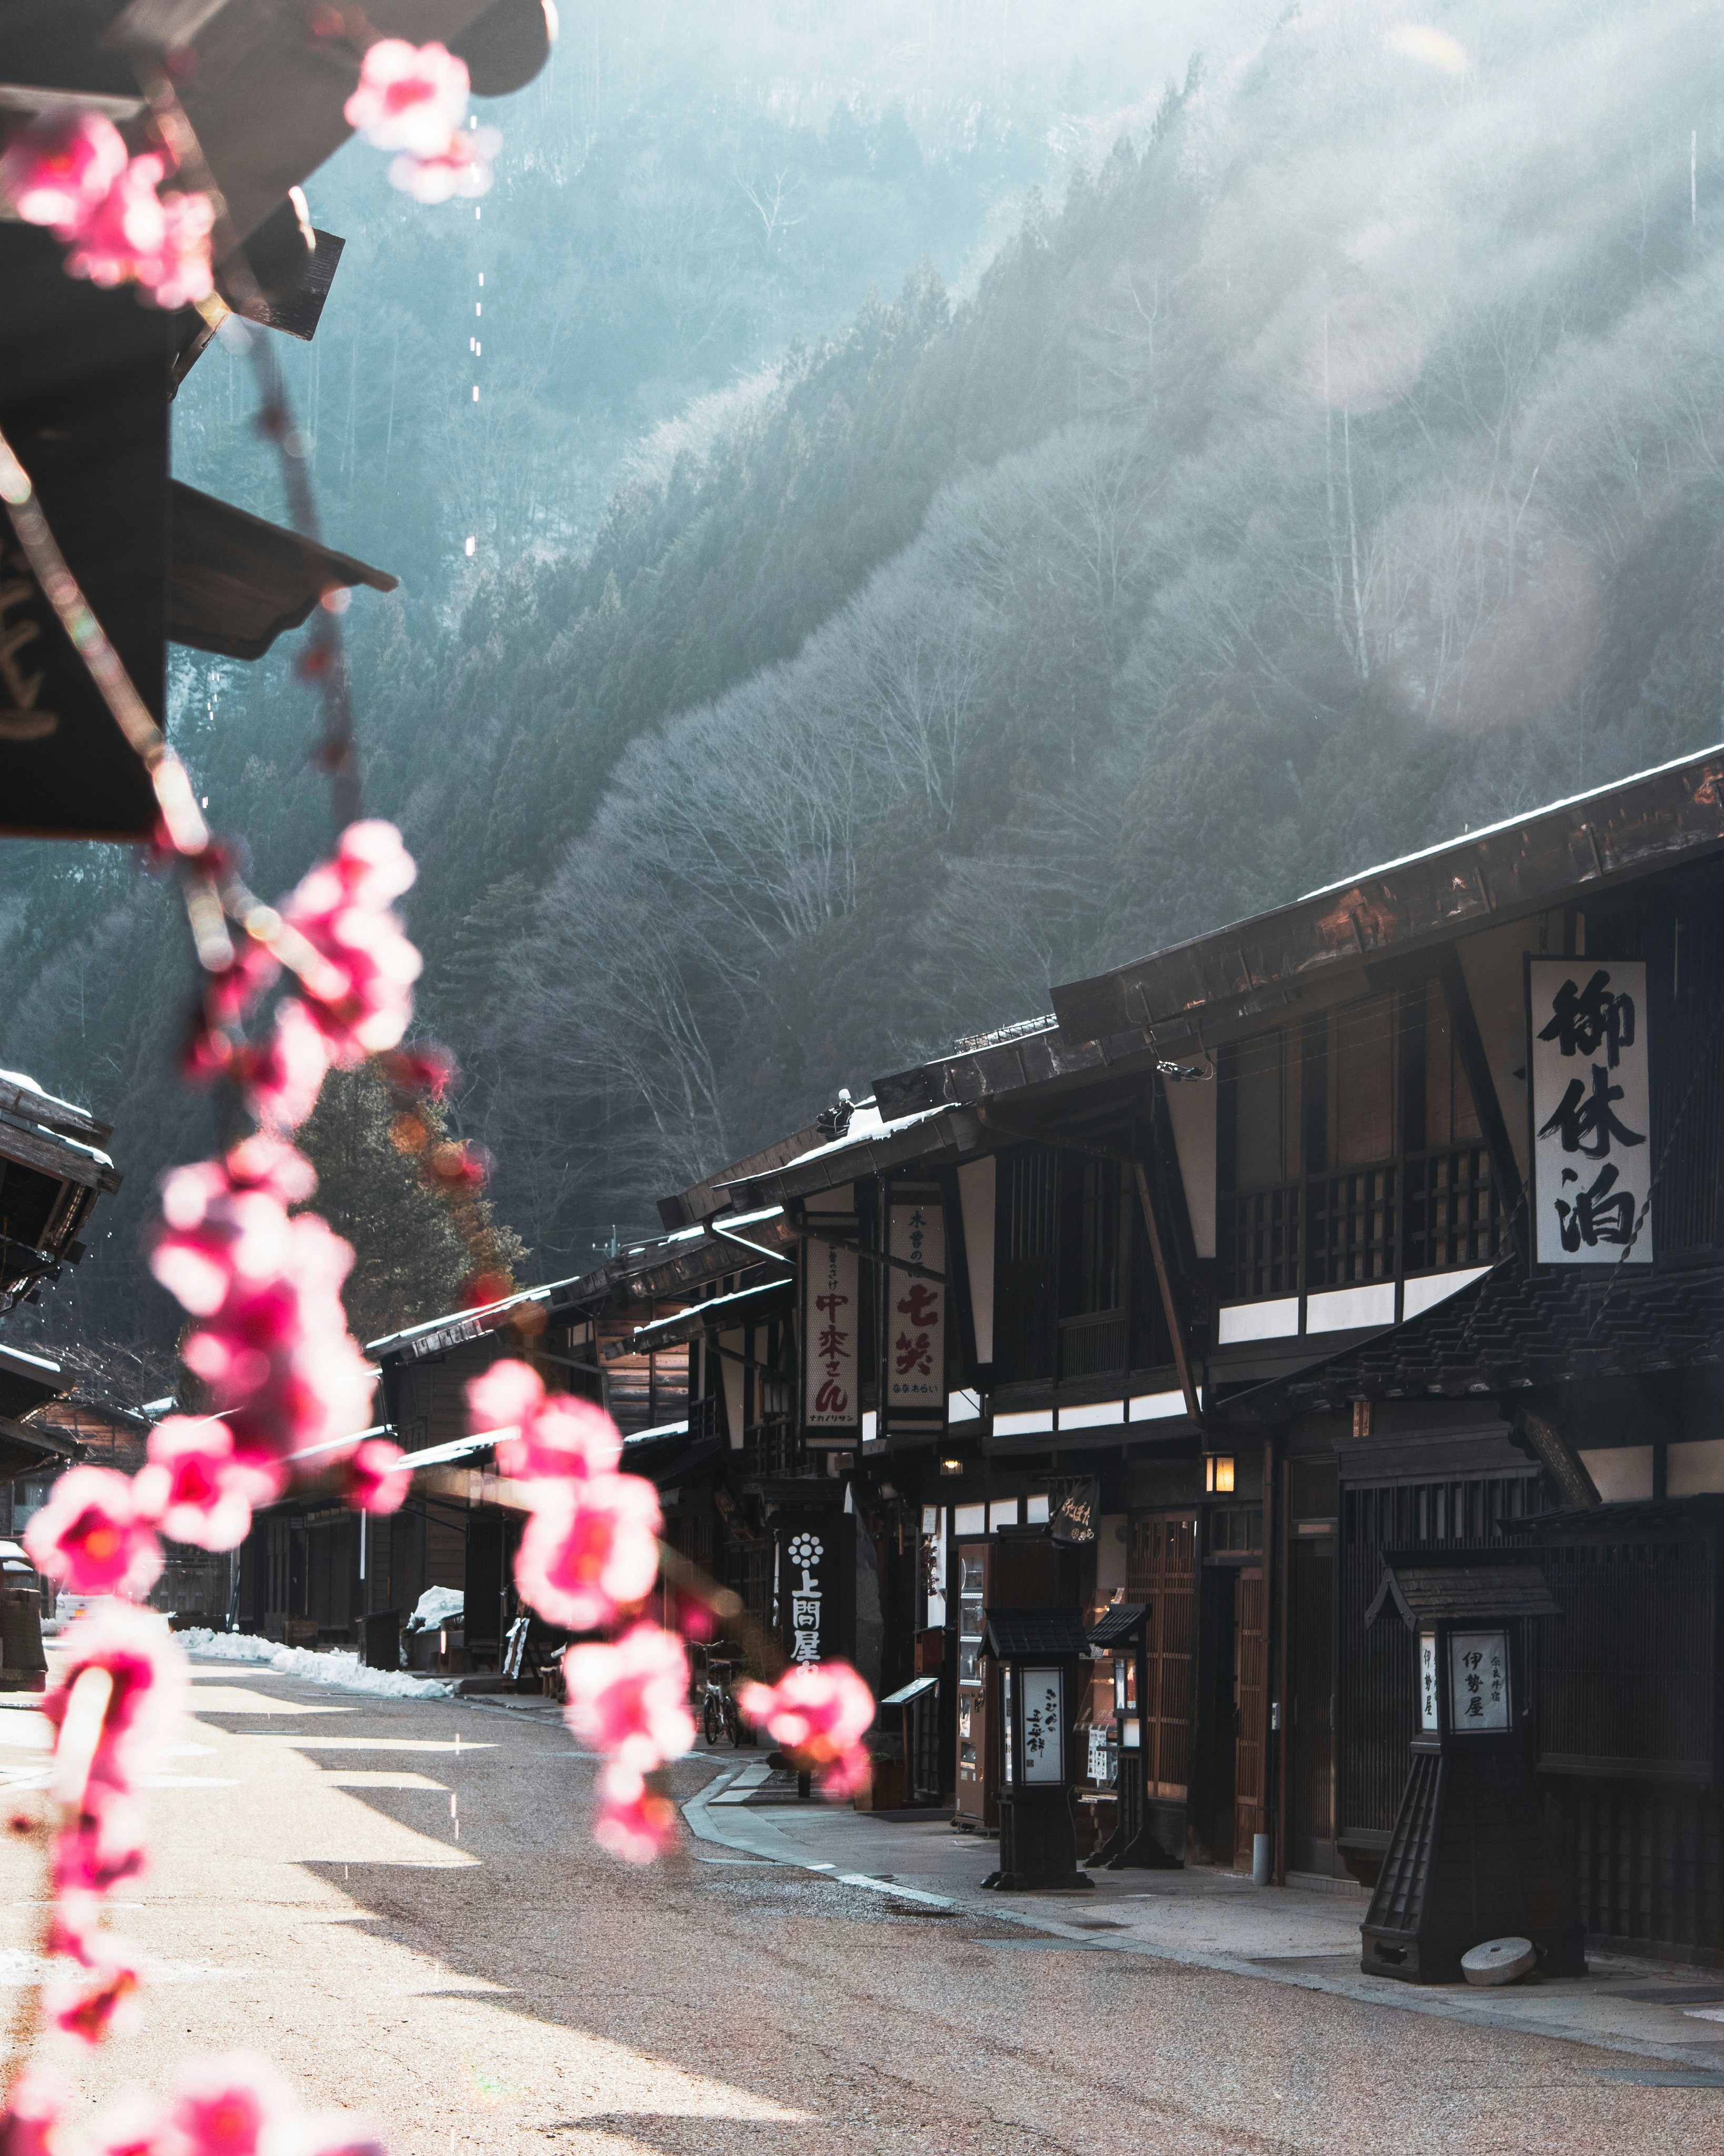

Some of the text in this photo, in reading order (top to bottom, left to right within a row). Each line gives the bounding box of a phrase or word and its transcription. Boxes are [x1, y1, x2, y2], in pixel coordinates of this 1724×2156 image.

[1536, 970, 1646, 1252] 御休泊
[908, 1210, 926, 1278] 木曽の
[896, 1284, 939, 1376] 七笑
[893, 1384, 937, 1393] ななわらい
[1046, 1689, 1057, 1732] きむらの
[1424, 1649, 1432, 1715] 伊勢屋
[1462, 1651, 1484, 1717] 伊勢屋
[1491, 1656, 1501, 1702] 奈良井宿
[1026, 1709, 1045, 1758] 五平餅
